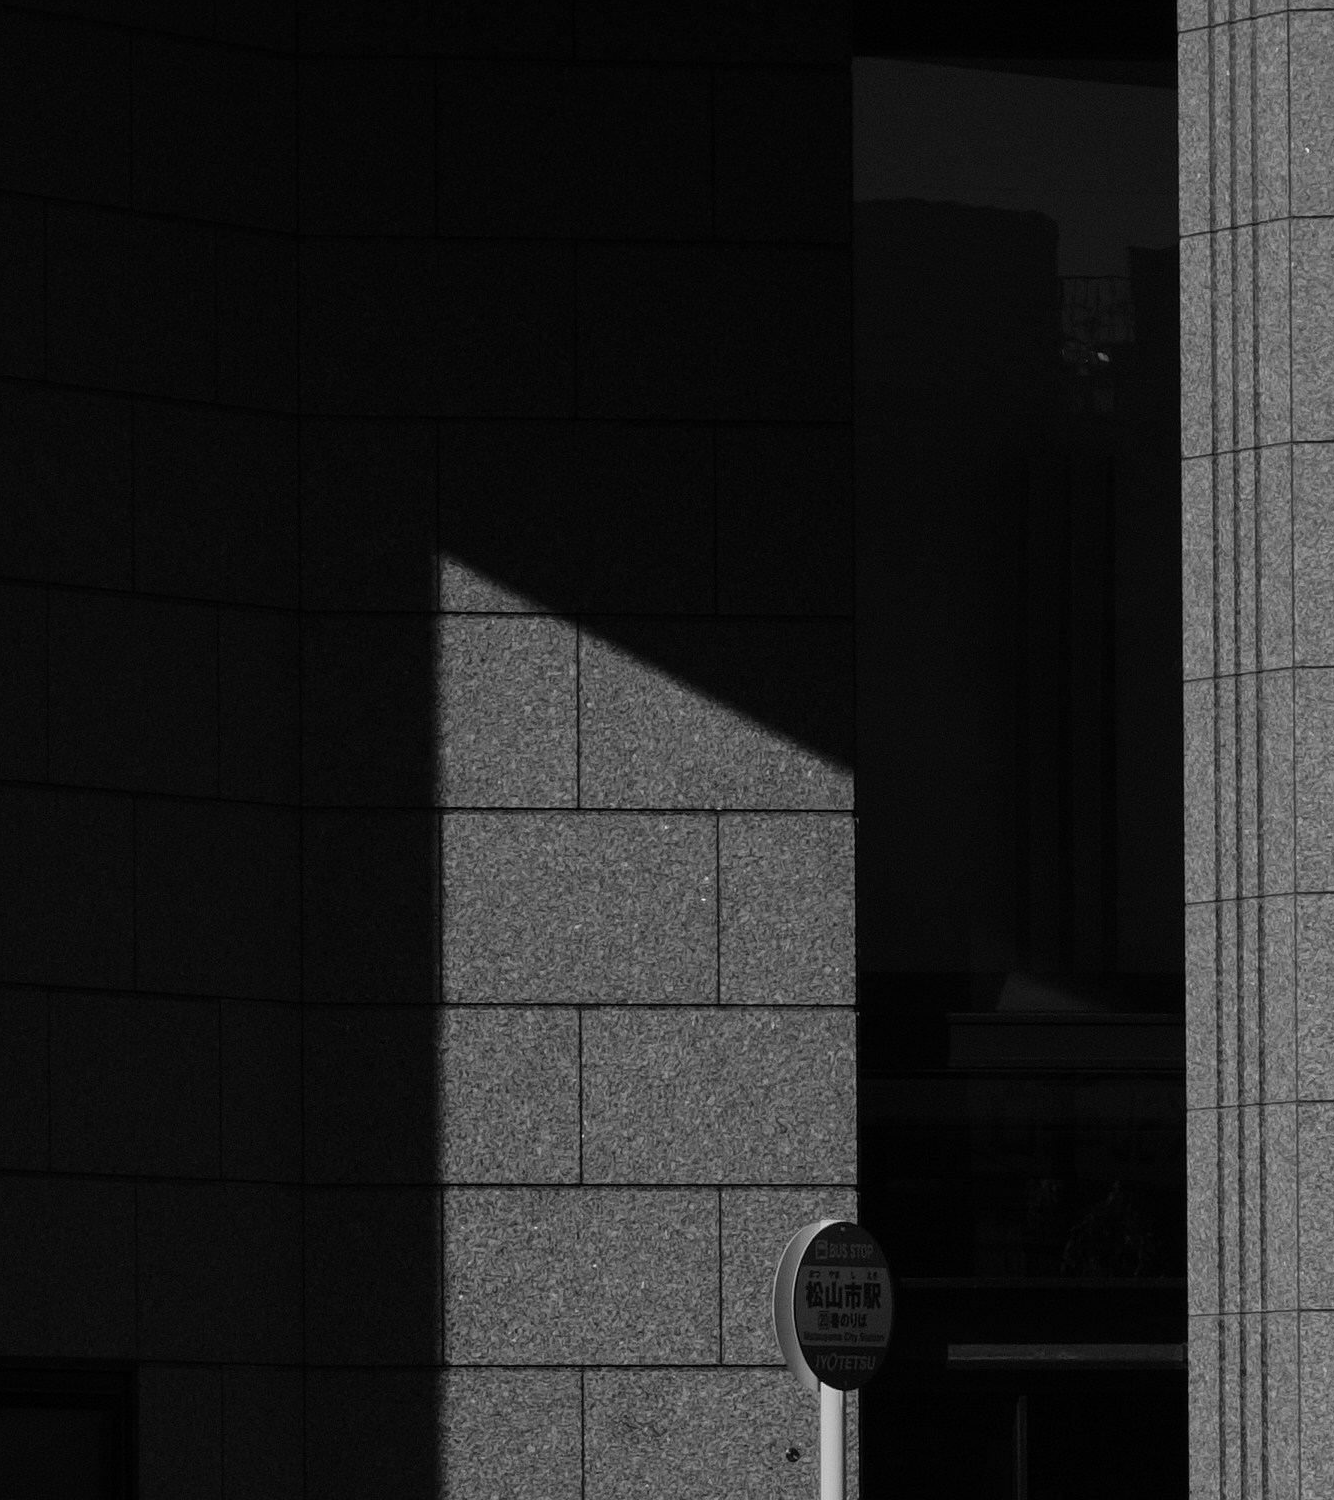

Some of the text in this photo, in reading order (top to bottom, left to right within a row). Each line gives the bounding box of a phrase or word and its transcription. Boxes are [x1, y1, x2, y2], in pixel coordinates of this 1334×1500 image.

[829, 1242, 874, 1260] BUS STOP
[805, 1280, 882, 1309] 松山市駅
[844, 1331, 858, 1343] City
[859, 1331, 885, 1343] Station
